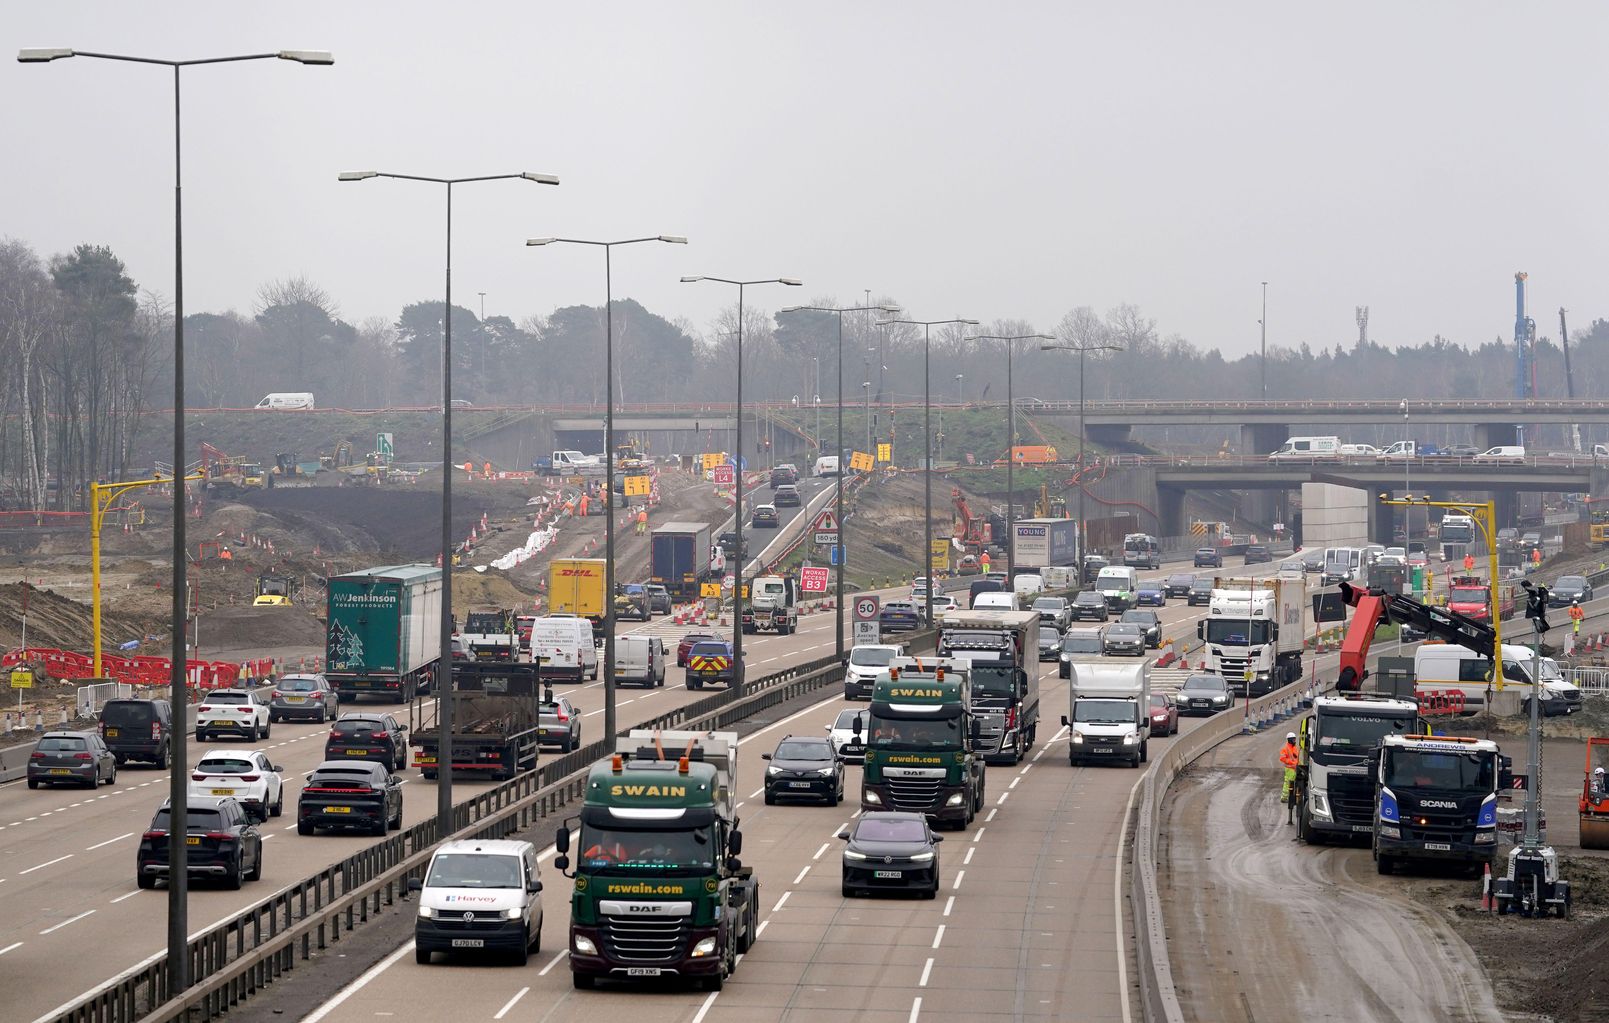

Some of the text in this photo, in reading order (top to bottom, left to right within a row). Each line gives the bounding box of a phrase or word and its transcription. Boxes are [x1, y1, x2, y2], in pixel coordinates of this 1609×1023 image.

[1018, 528, 1045, 536] YOUNG
[806, 581, 821, 589] B3
[859, 604, 874, 613] 50
[890, 688, 943, 697] SWAIN
[1416, 742, 1466, 750] ANDREWS
[888, 754, 942, 763] rswain.com
[610, 785, 687, 797] SWAIN
[1419, 800, 1458, 809] SCANIA
[607, 882, 685, 894] rswain.com
[457, 895, 498, 903] Harvey
